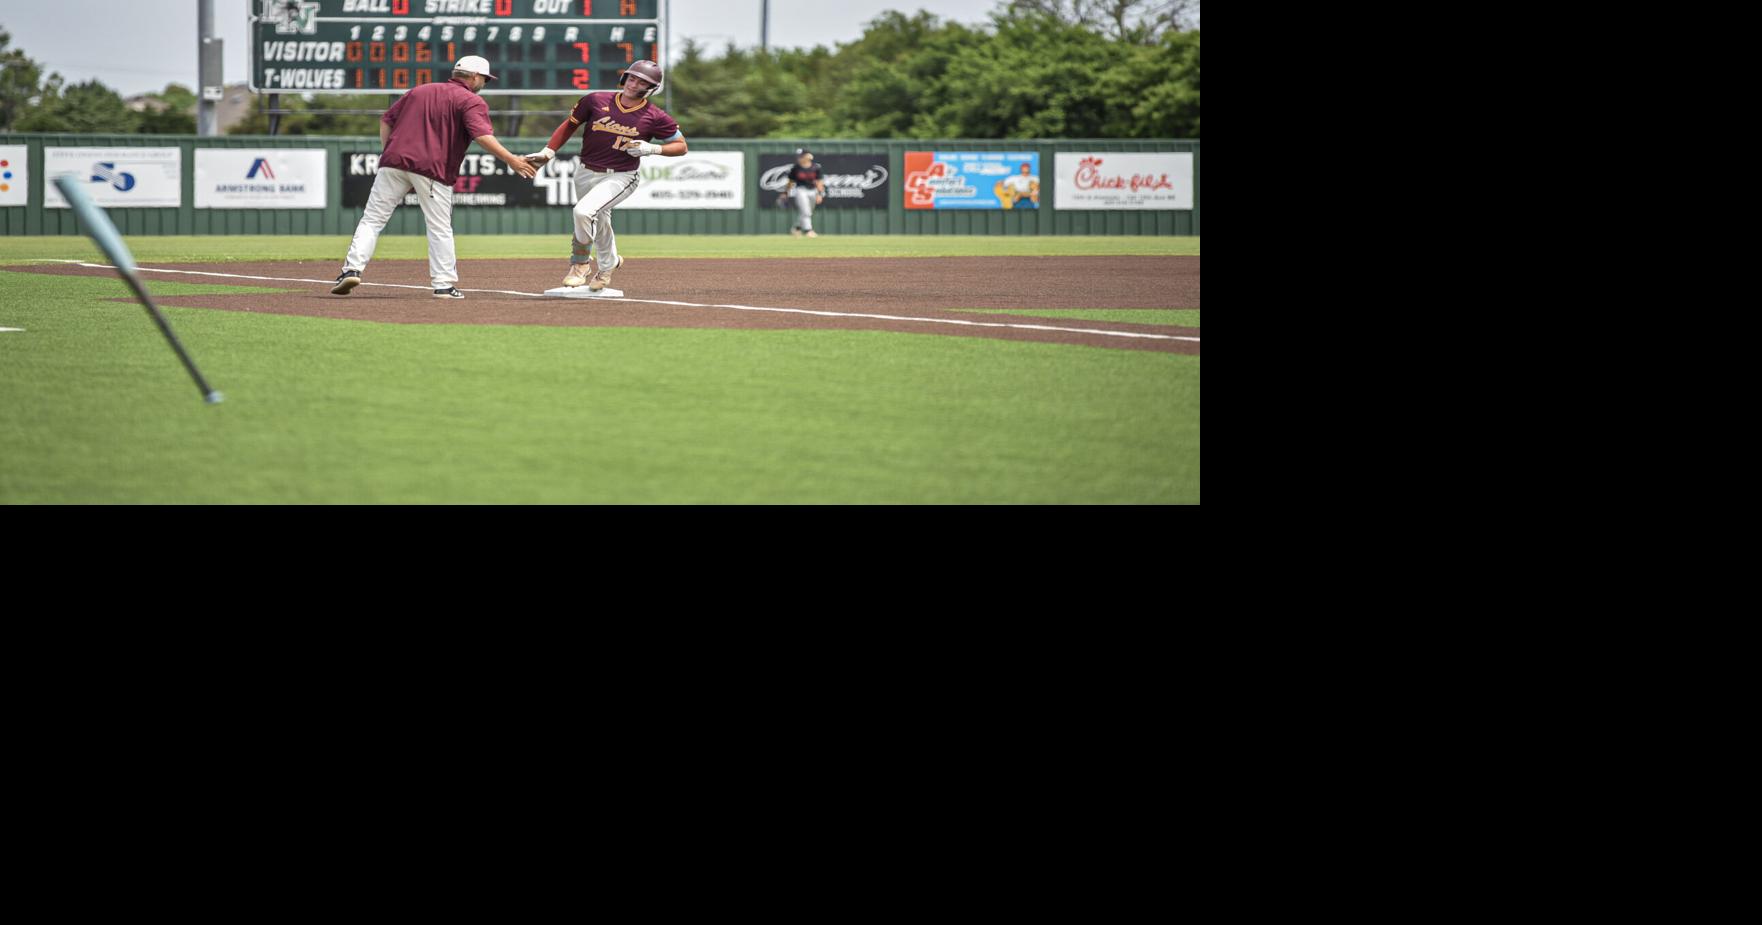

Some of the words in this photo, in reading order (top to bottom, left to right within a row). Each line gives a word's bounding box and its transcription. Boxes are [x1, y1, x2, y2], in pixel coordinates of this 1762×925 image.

[342, 0, 391, 13] BALL
[425, 0, 492, 13] STRIKE
[533, 0, 572, 14] OUT
[350, 25, 361, 41] 1
[371, 25, 386, 41] 2
[394, 25, 409, 41] 3
[418, 25, 432, 41] 4
[440, 26, 454, 41] 5
[463, 26, 477, 41] 6
[487, 26, 499, 41] 7
[508, 26, 523, 41] 8
[532, 26, 546, 41] 9
[564, 26, 579, 41] R
[610, 26, 625, 41] H
[643, 26, 657, 41] E
[263, 41, 345, 62] VISITOR
[392, 42, 409, 62] 0
[447, 42, 455, 62] 1
[572, 42, 590, 64] 7
[616, 42, 634, 62] 7
[264, 68, 346, 89] T-WOLVES
[355, 68, 363, 89] 1
[572, 69, 590, 89] 2
[591, 115, 640, 137] Lions
[612, 135, 635, 151] 17
[215, 183, 276, 193] ARMSTRONG
[279, 183, 305, 193] BANK
